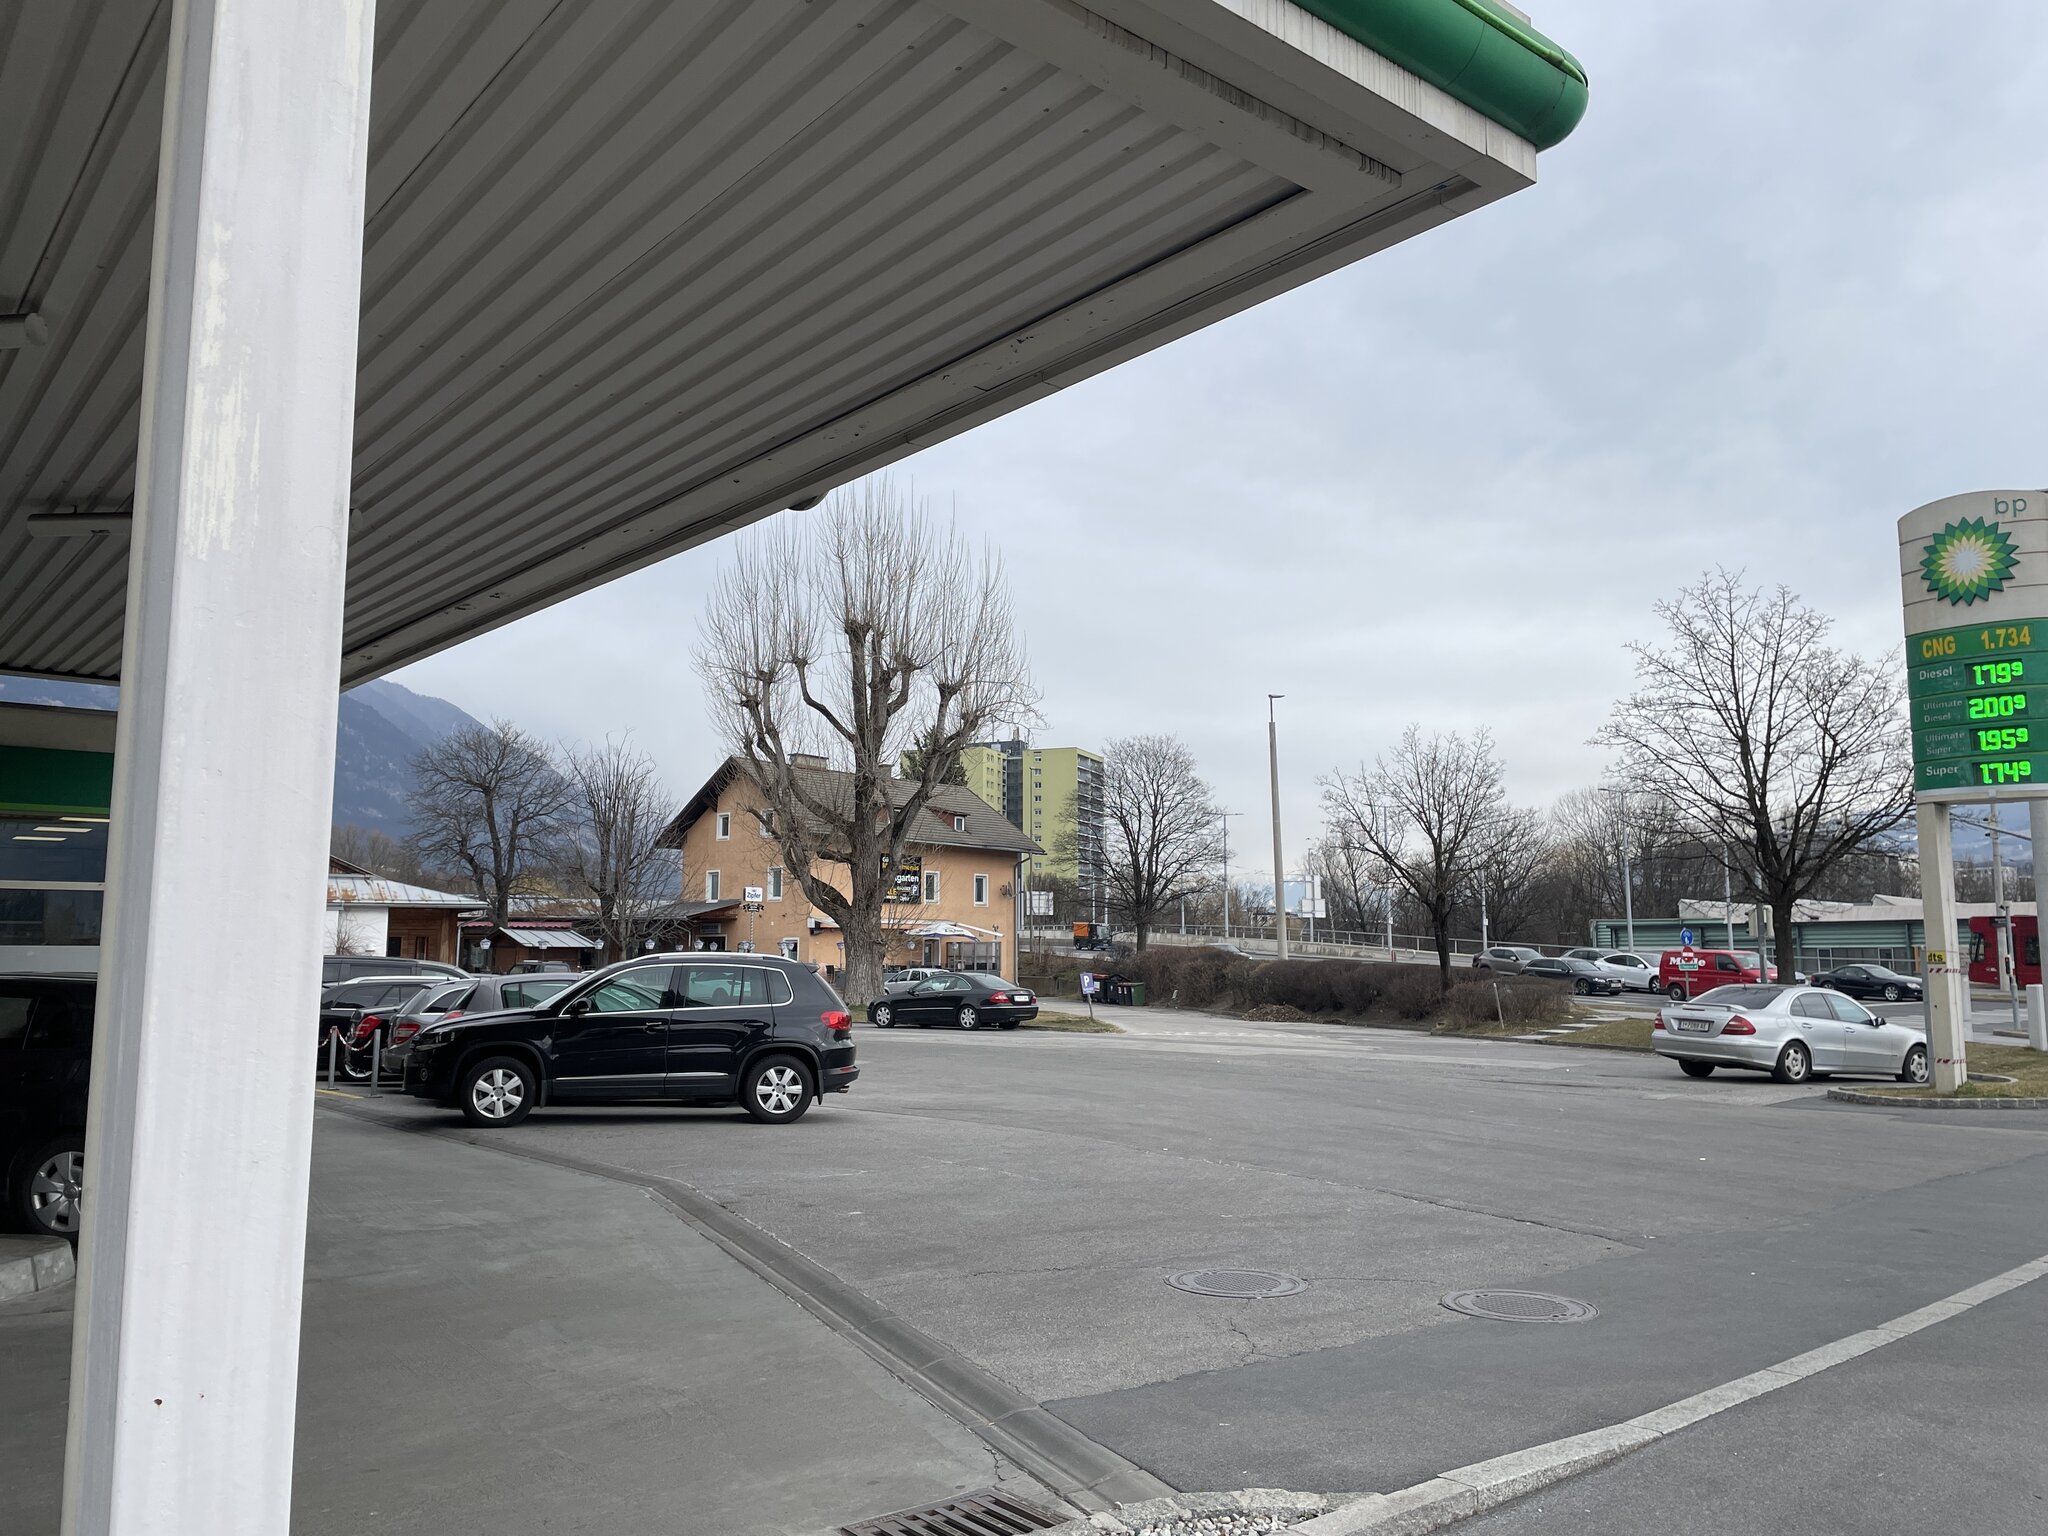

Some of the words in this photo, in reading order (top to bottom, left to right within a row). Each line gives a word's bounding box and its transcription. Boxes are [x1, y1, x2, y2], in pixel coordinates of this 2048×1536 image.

[1994, 497, 2027, 518] bp
[1922, 635, 1956, 658] CNG
[1981, 625, 2031, 650] 1.734
[1919, 665, 1953, 680] Diesel
[1923, 699, 1963, 711] Ultimate
[1924, 712, 1952, 723] Diesel
[1925, 731, 1965, 742] Ultimate
[1926, 766, 1959, 777] Super
